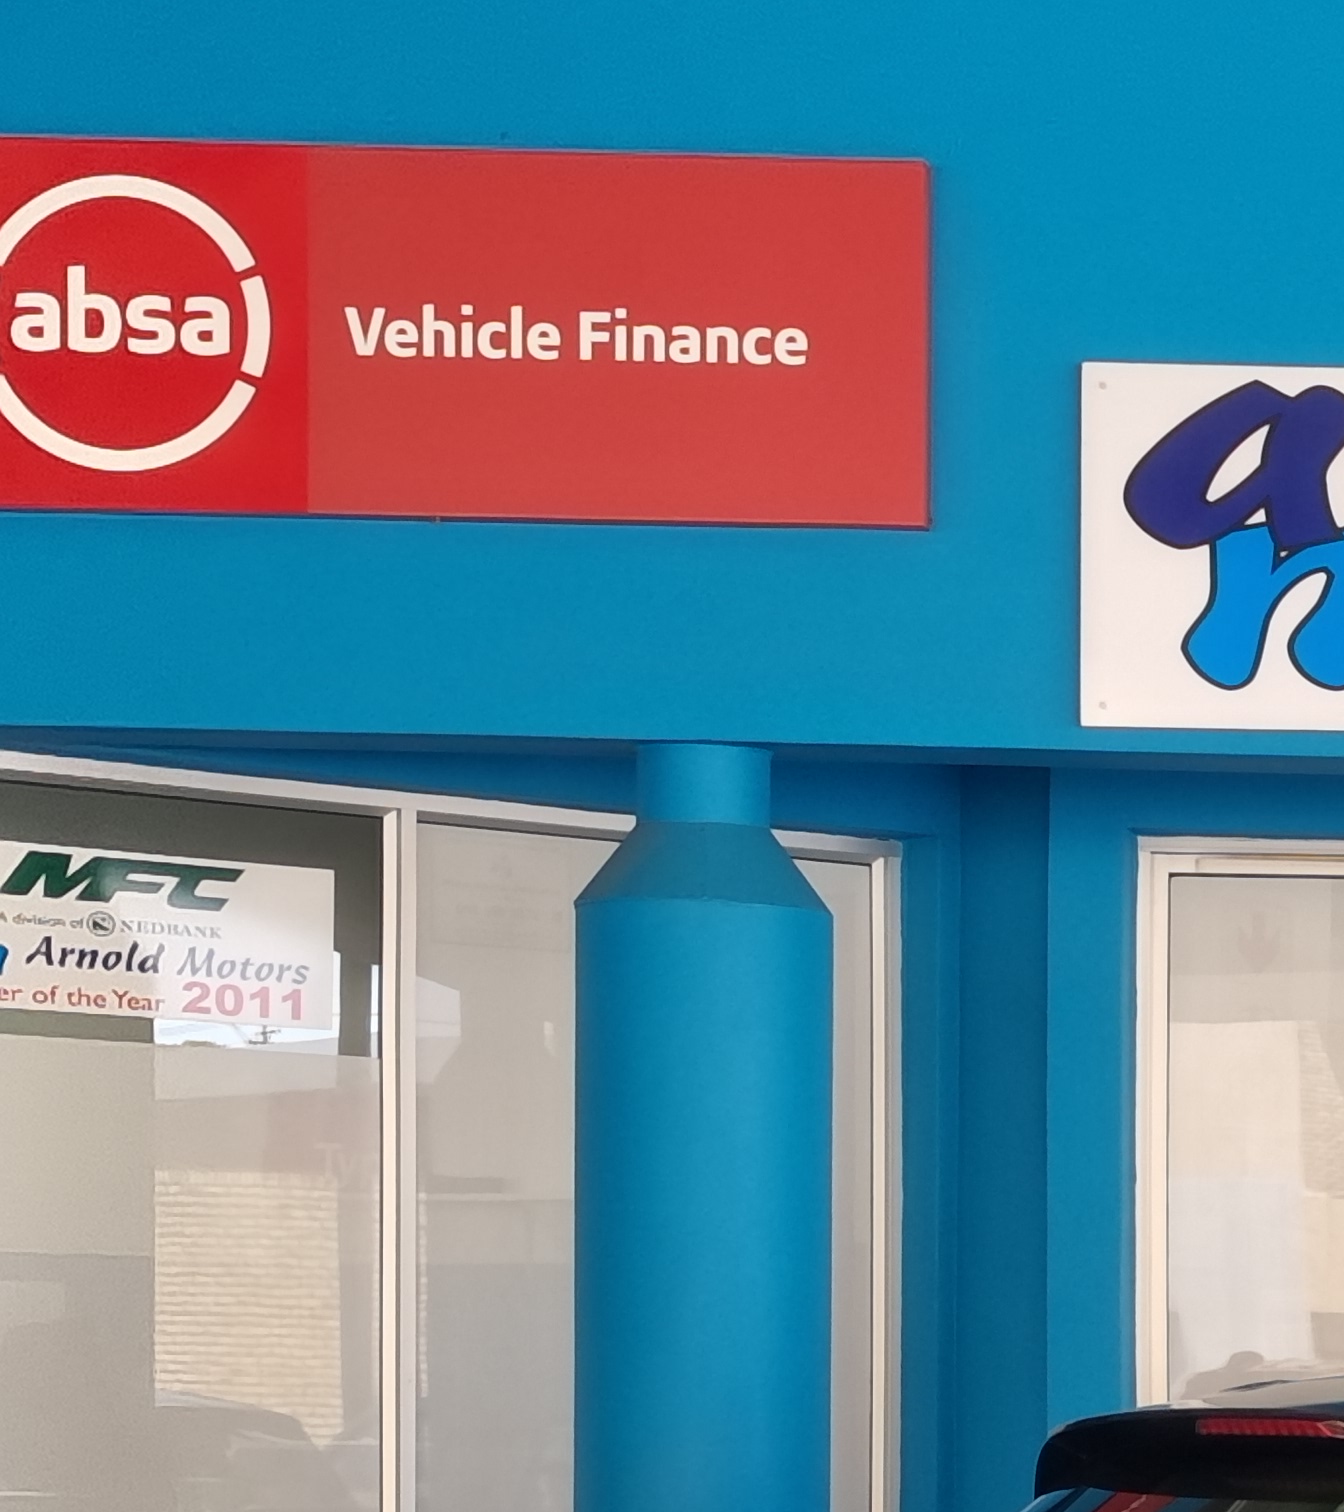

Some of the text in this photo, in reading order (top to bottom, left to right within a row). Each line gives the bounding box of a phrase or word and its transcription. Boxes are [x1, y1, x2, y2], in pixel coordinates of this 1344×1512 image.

[11, 265, 231, 355] absa
[344, 304, 809, 367] Vehicle Finance
[0, 850, 245, 912] MFC
[119, 919, 222, 940] NEDBANK
[25, 935, 165, 974] Arnold
[176, 944, 310, 985] Motors
[31, 985, 60, 1004] of
[67, 987, 107, 1009] the
[112, 989, 165, 1011] Year
[181, 981, 302, 1021] 2011
